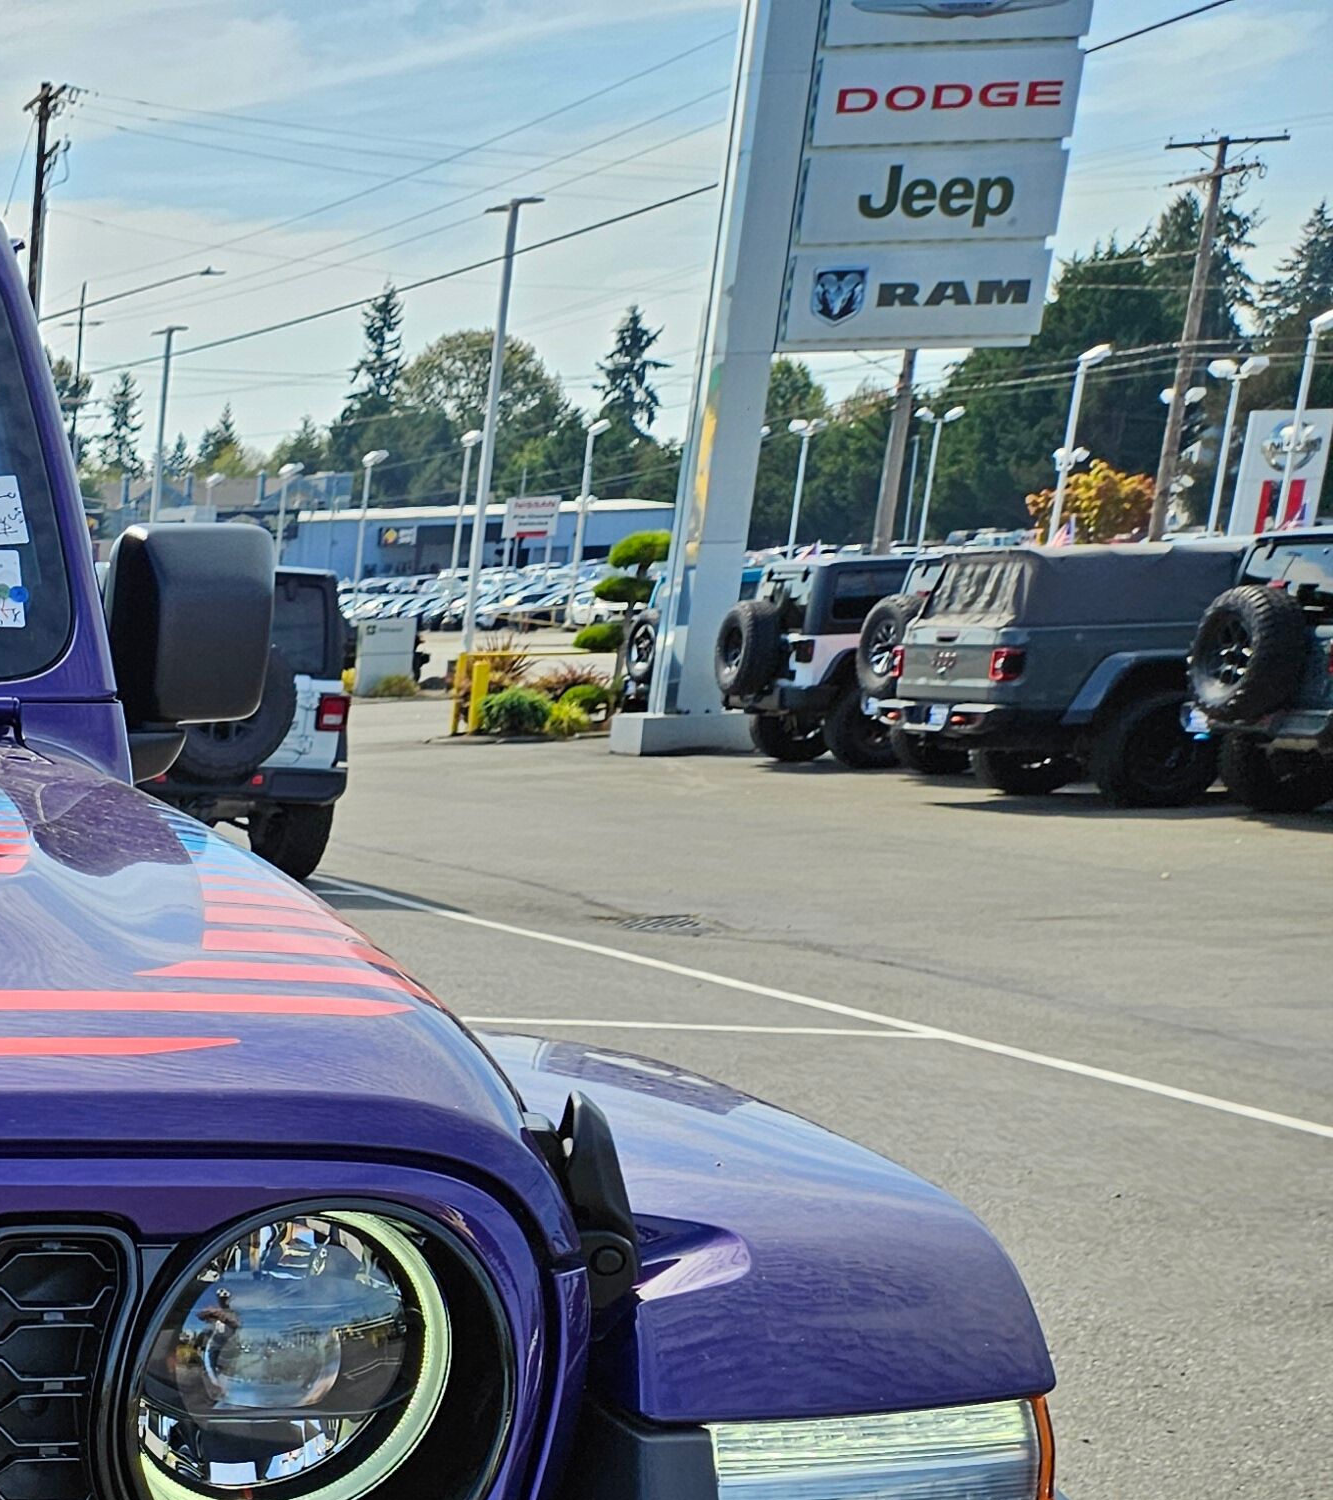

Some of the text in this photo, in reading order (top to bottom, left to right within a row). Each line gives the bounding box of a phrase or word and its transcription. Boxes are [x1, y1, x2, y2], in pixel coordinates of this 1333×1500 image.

[836, 80, 1064, 114] DODGE
[858, 164, 1015, 228] Jeep
[876, 279, 1032, 308] RAM
